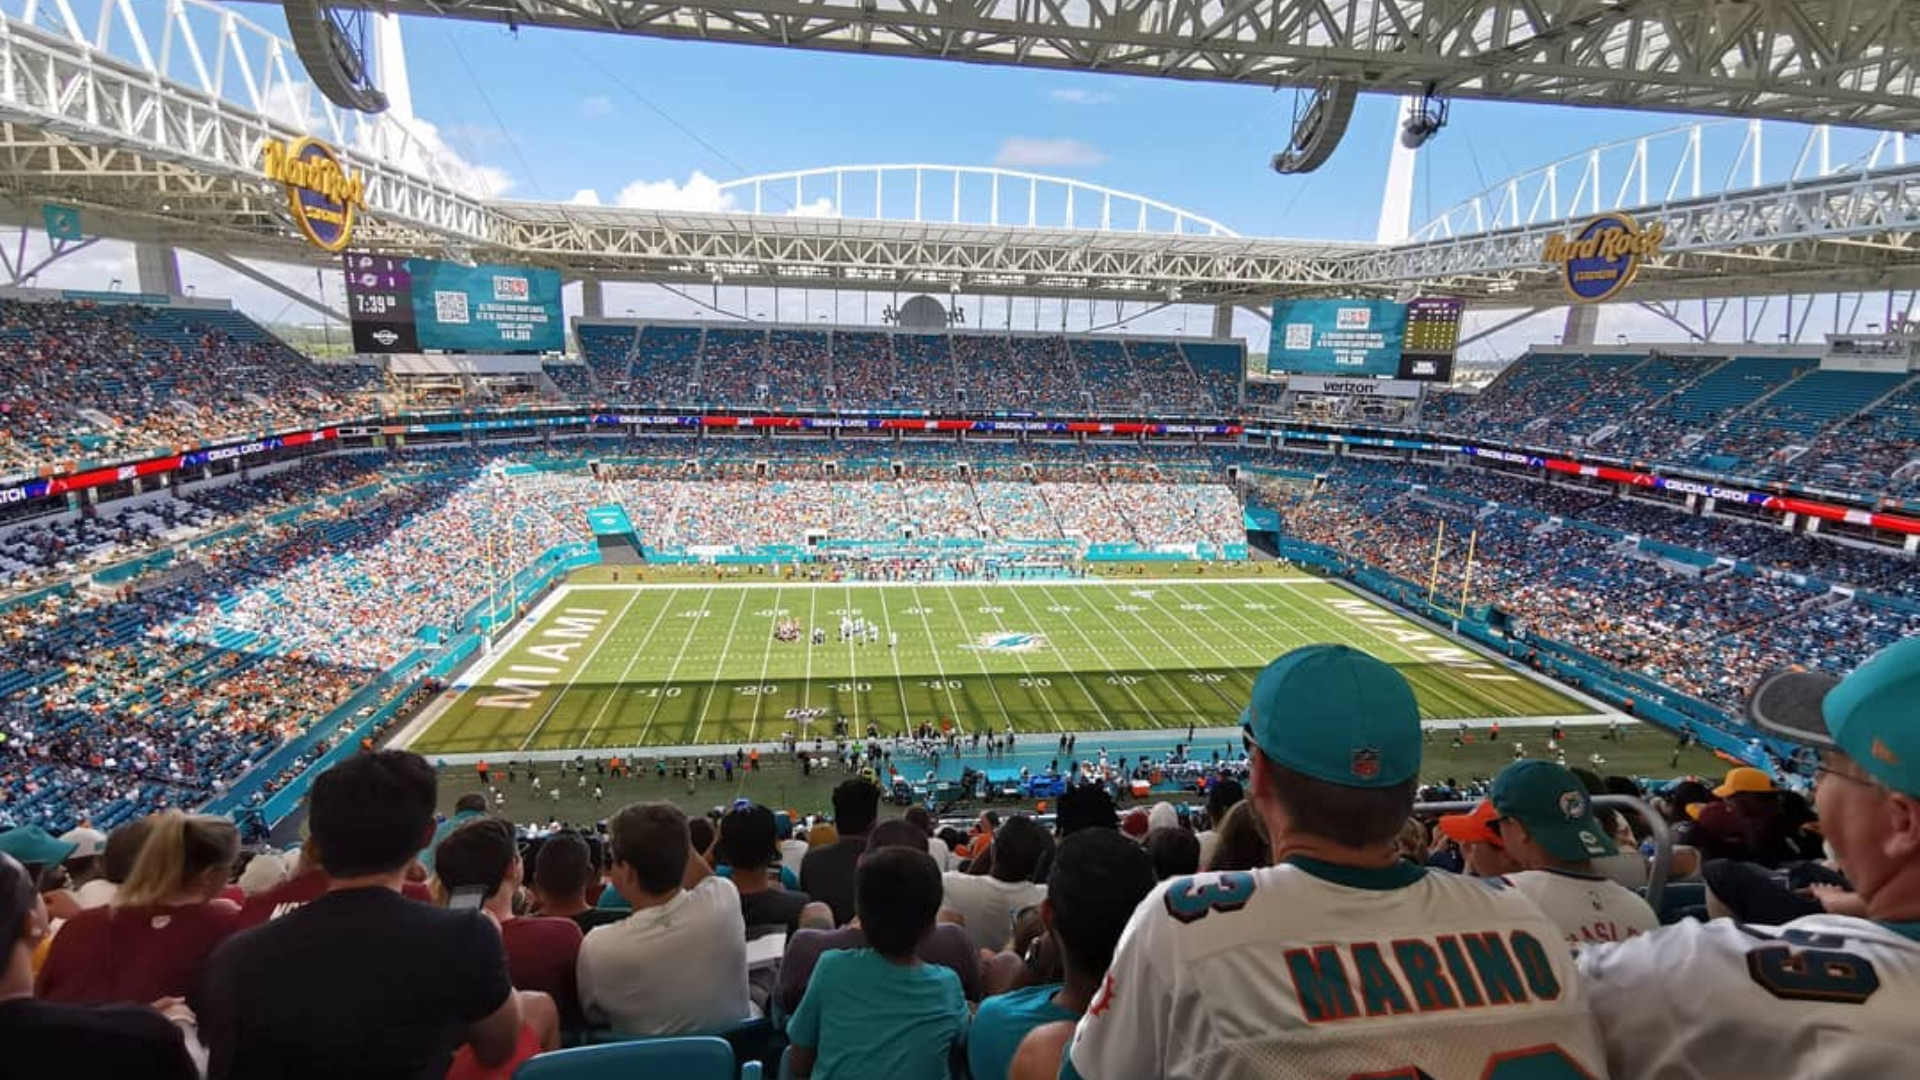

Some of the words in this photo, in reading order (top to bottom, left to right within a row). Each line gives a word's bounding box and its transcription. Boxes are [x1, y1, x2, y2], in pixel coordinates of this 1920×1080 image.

[1323, 381, 1374, 393] verizon
[0, 488, 26, 503] TCH
[1665, 480, 1710, 496] CRUCIAL
[1711, 488, 1748, 503] CATCH
[1323, 598, 1521, 681] MIAMI
[475, 607, 609, 709] MIAMI
[837, 682, 872, 692] 30
[929, 680, 963, 690] 40
[1018, 677, 1051, 687] 50
[646, 686, 682, 698] 10
[741, 685, 778, 696] 20
[1284, 929, 1561, 1024] MARINO
